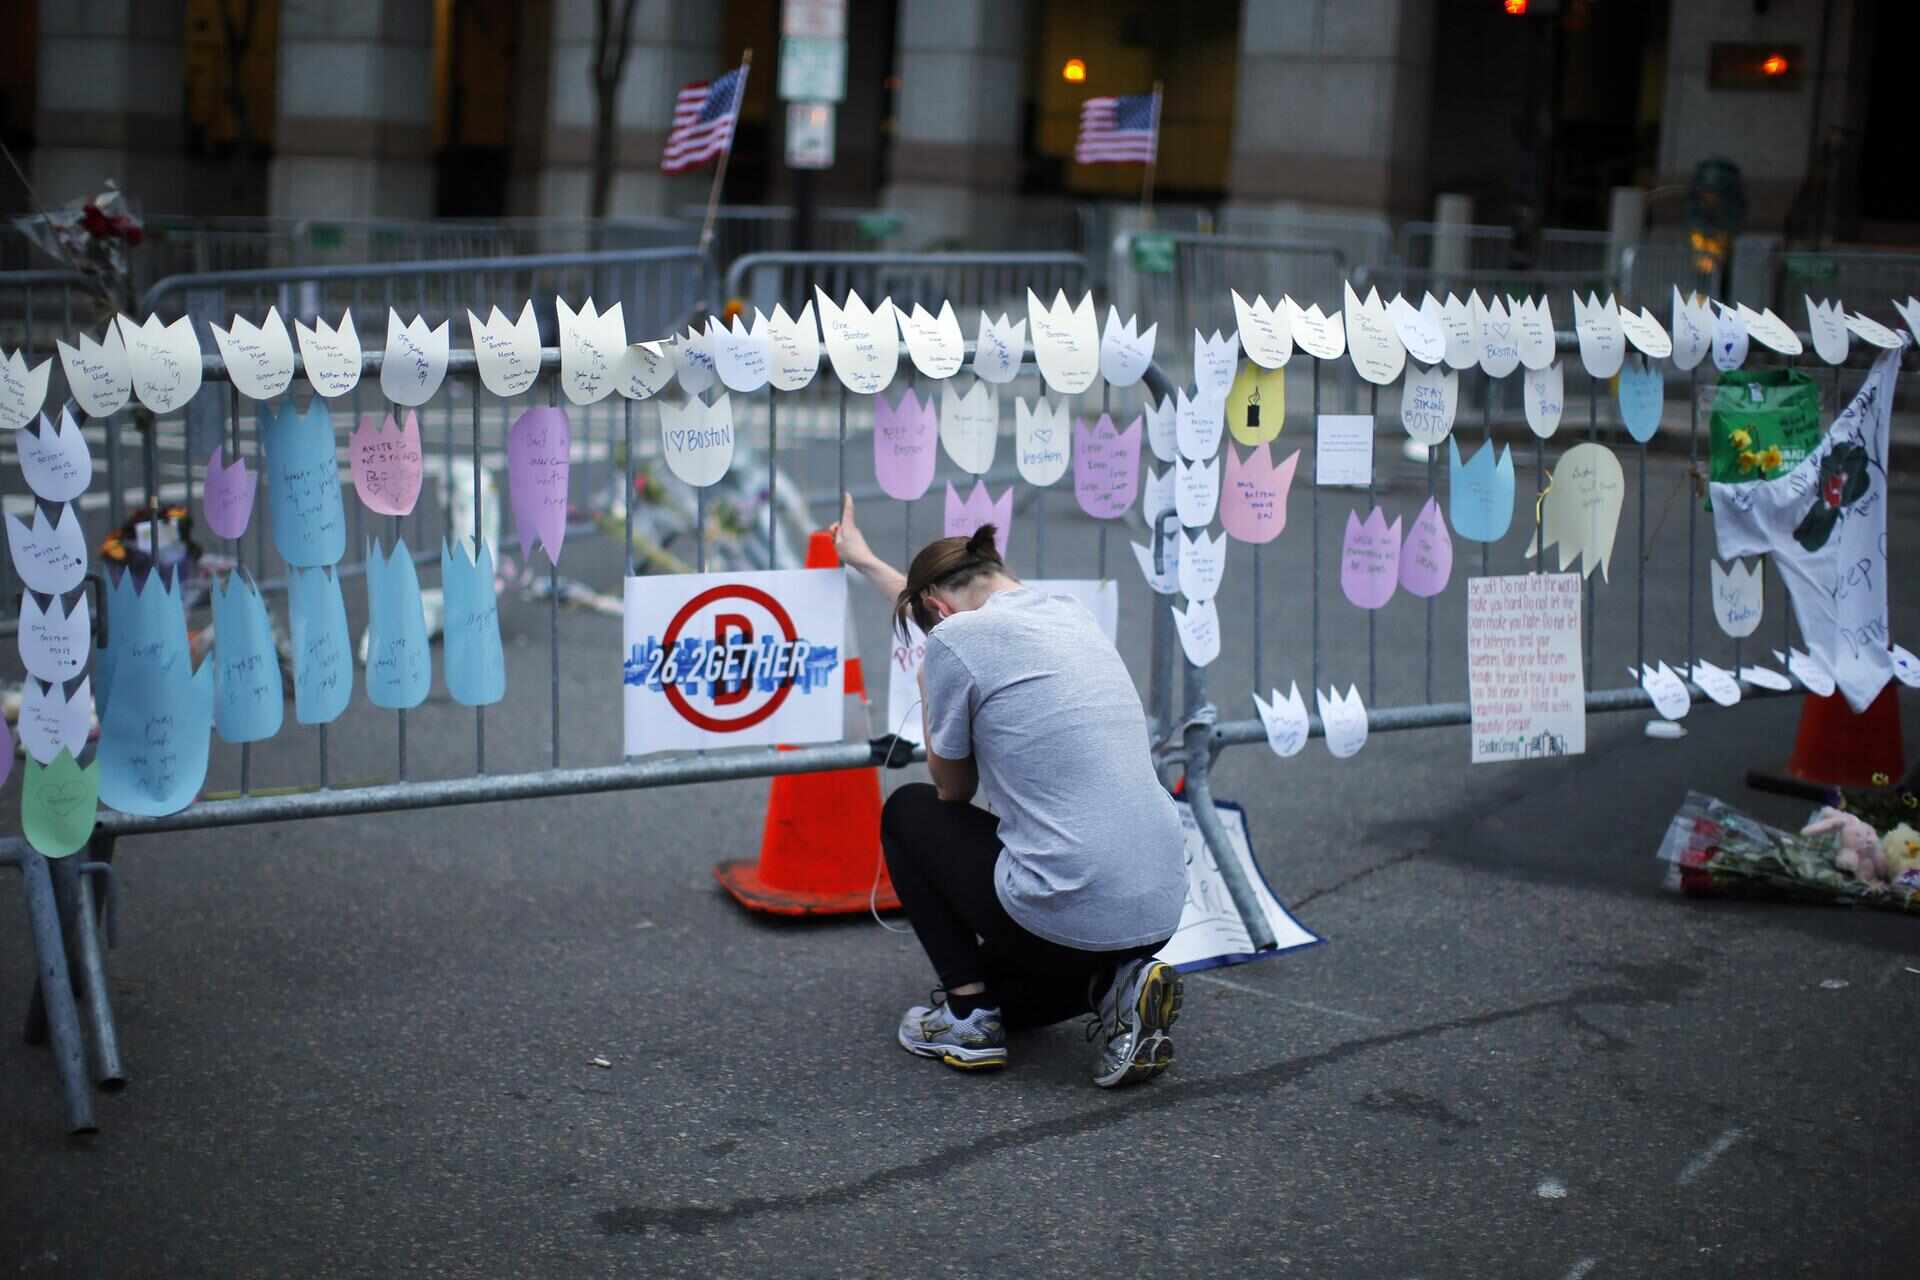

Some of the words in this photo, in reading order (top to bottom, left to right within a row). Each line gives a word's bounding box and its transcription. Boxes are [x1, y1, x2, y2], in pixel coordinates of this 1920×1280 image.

[1416, 385, 1442, 398] STAY
[1404, 410, 1450, 434] BOSTON
[646, 640, 810, 686] 26.2GETHER
